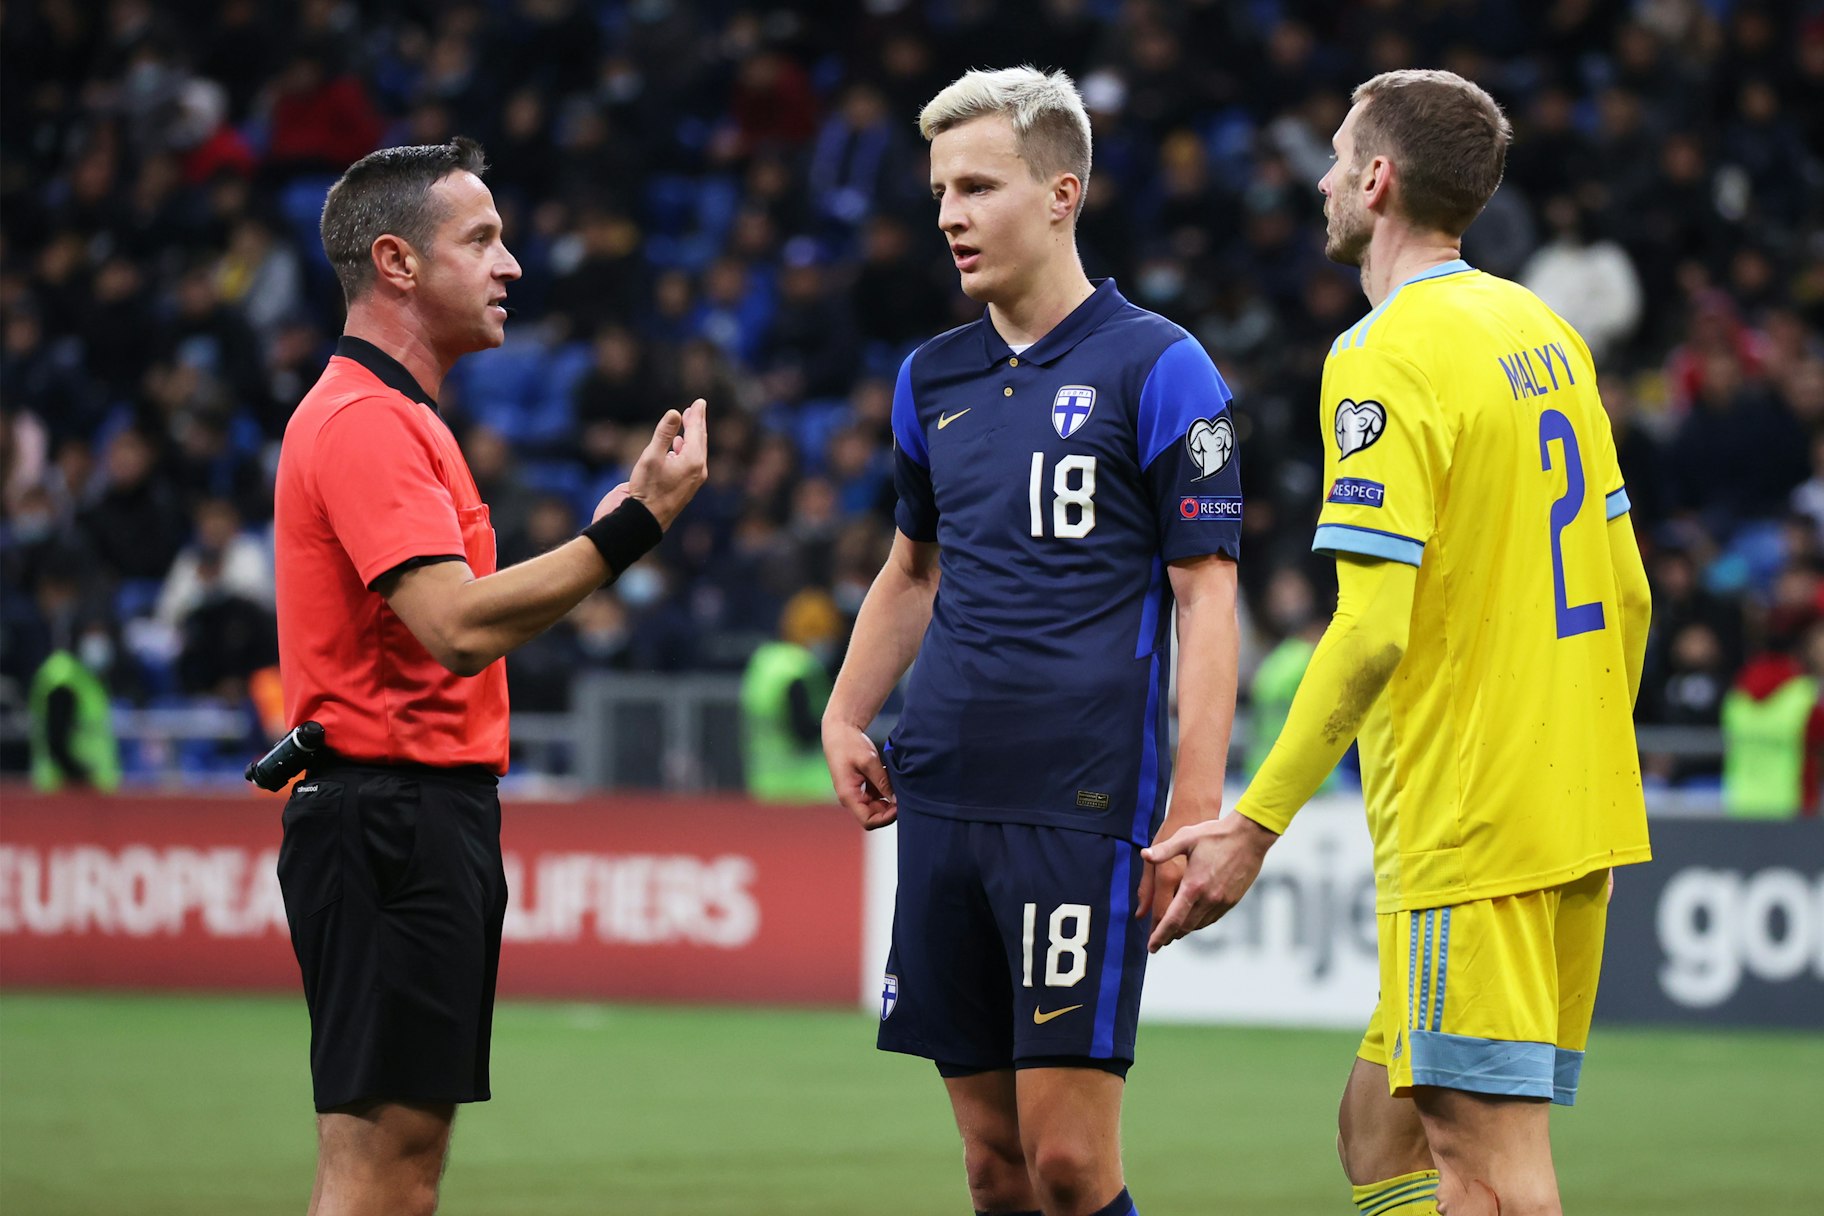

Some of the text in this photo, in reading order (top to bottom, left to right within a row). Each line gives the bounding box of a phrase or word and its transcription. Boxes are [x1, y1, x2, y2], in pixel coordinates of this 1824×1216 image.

[1498, 342, 1575, 400] MALYY
[1029, 452, 1097, 539] 18
[1200, 502, 1242, 514] RESPECT
[1333, 484, 1384, 500] RESPECT
[1539, 409, 1606, 639] 2
[0, 843, 761, 947] EUROPEA LIFIERS
[1022, 902, 1092, 988] 18
